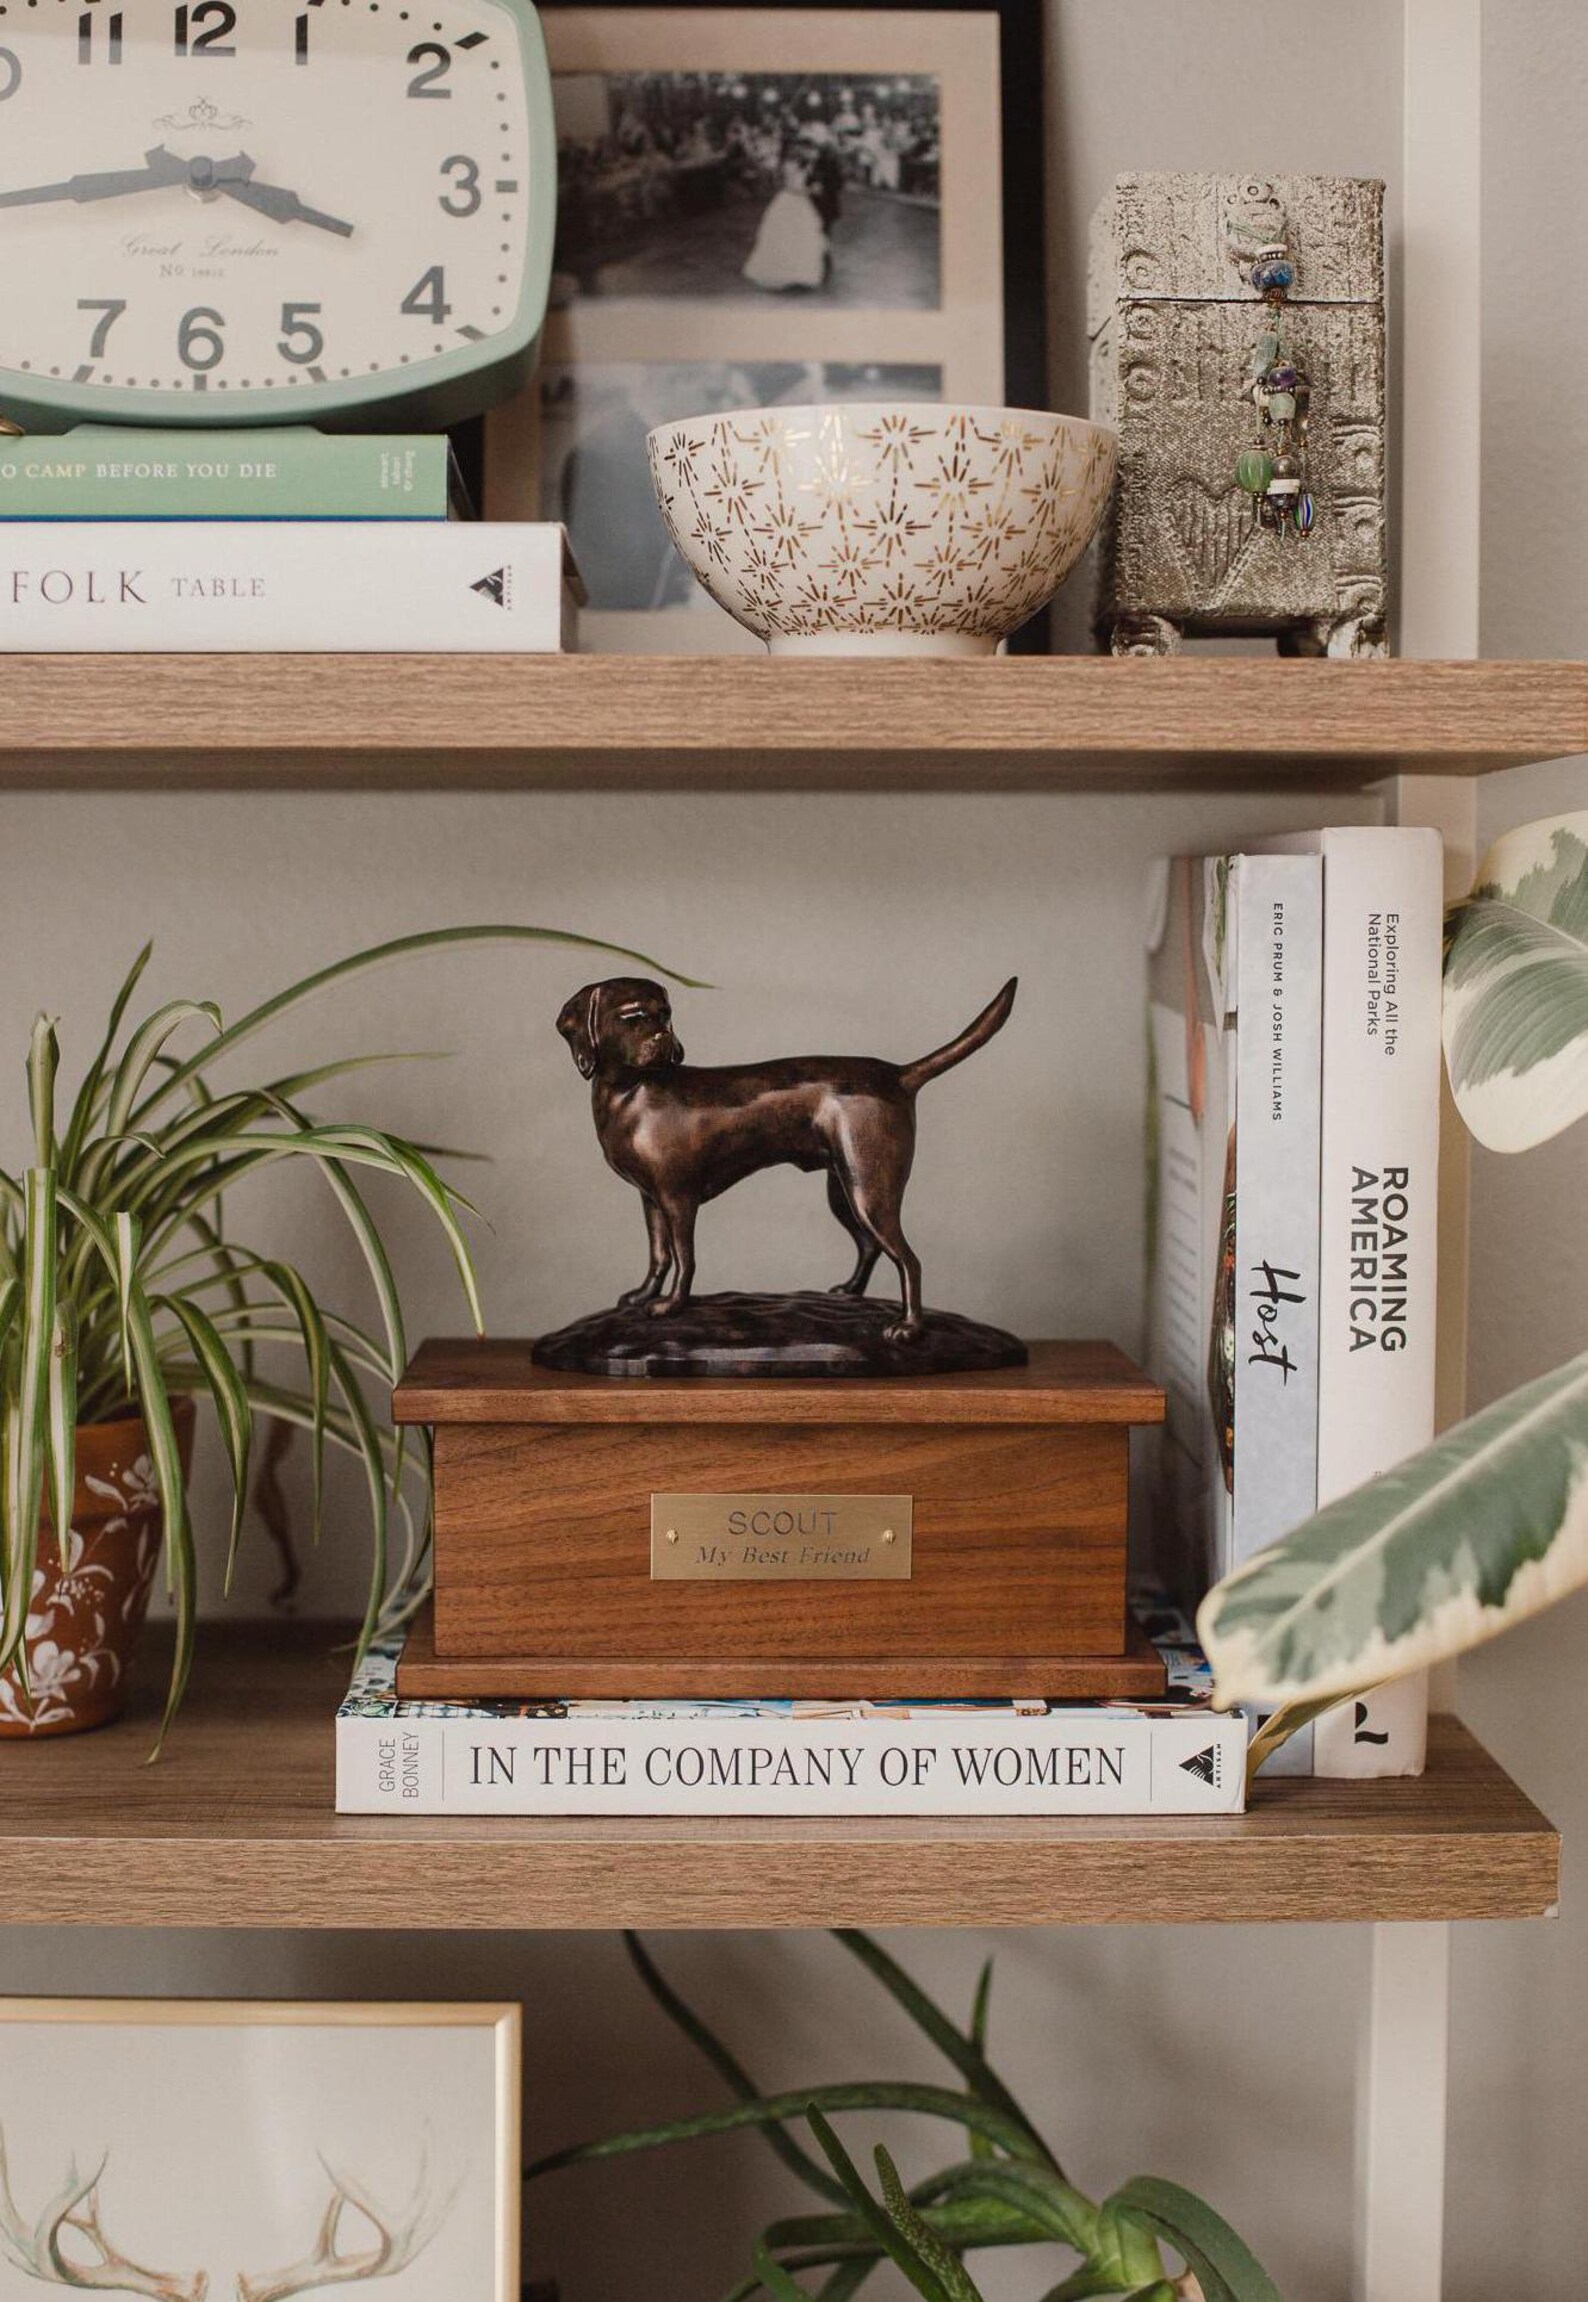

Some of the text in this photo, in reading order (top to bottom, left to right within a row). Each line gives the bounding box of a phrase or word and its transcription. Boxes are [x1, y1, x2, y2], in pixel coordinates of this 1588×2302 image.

[78, 12, 123, 65] 11
[174, 1, 237, 57] 12
[295, 13, 309, 65] 1
[406, 42, 452, 99] 2
[439, 155, 481, 217] 3
[199, 234, 279, 257] London
[401, 266, 451, 324] 4
[77, 299, 126, 358] 7
[178, 307, 225, 370] 6
[278, 303, 323, 364] 5
[26, 464, 85, 477] CAMP
[97, 464, 177, 477] BEFORE
[187, 464, 228, 477] YOU
[240, 464, 276, 477] DIE
[14, 571, 264, 603] FOLK TABLE
[1274, 903, 1283, 935] ERIC
[1273, 943, 1282, 981] PRUM
[1367, 914, 1381, 1035] National Parks
[1384, 914, 1399, 1055] Exploring All the
[1273, 1004, 1282, 1041] JOSH
[1273, 1048, 1282, 1120] WILLIAMS
[1349, 1166, 1380, 1353] AMERICA
[1381, 1167, 1410, 1353] ROAMING
[1248, 1260, 1306, 1385] Host
[729, 1511, 837, 1535] SCOUT
[694, 1546, 870, 1567] My Best Friend
[379, 1739, 395, 1792] GRACE
[403, 1732, 419, 1797] BONNEY
[471, 1747, 1125, 1786] IN THE COMPANY OF WOMEN
